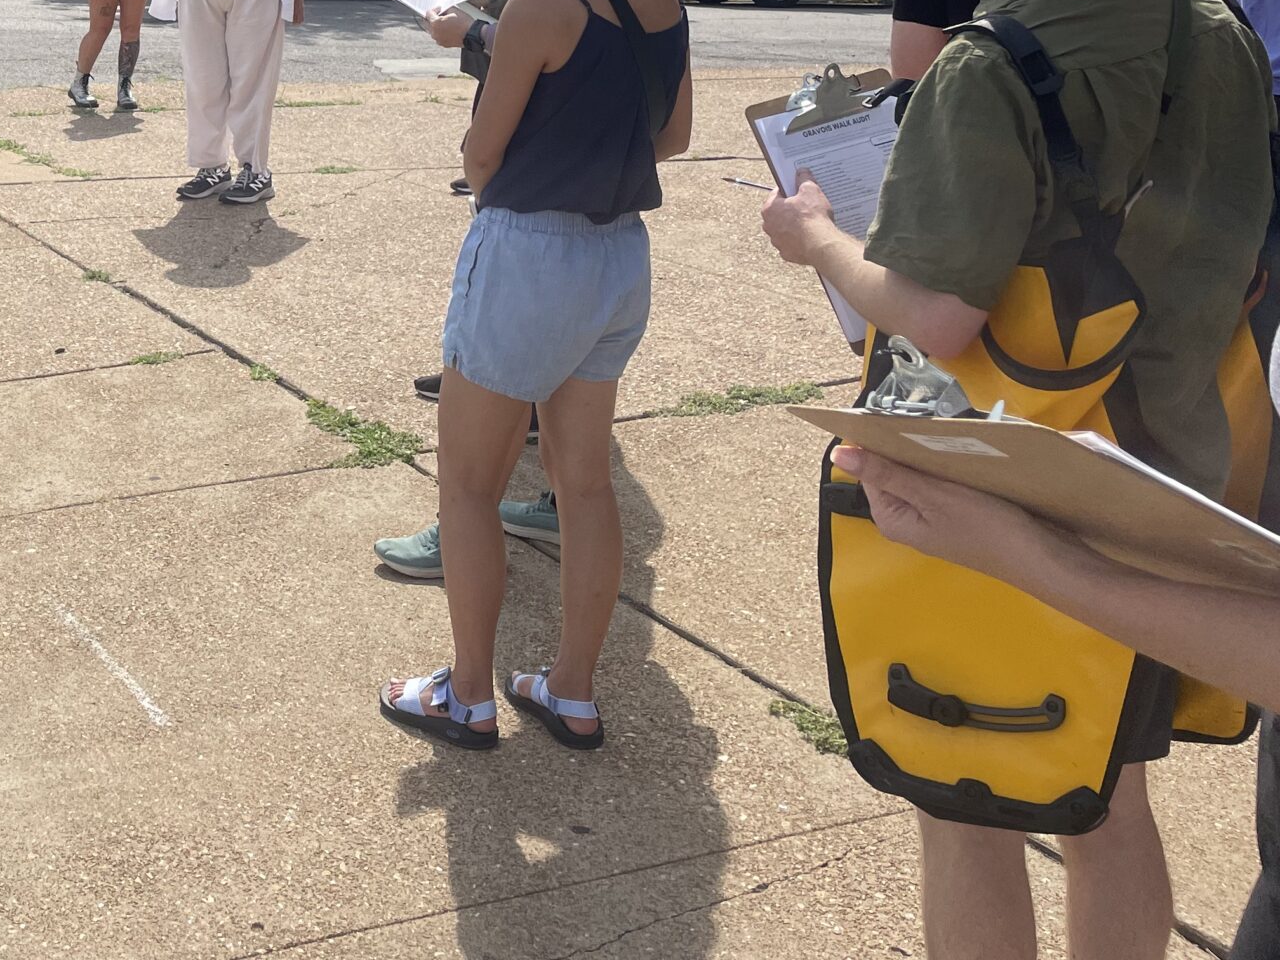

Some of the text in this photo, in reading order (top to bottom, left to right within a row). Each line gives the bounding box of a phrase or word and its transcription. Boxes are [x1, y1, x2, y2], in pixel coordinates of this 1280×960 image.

[802, 114, 871, 138] GRAVOIS WALK AUDIT
